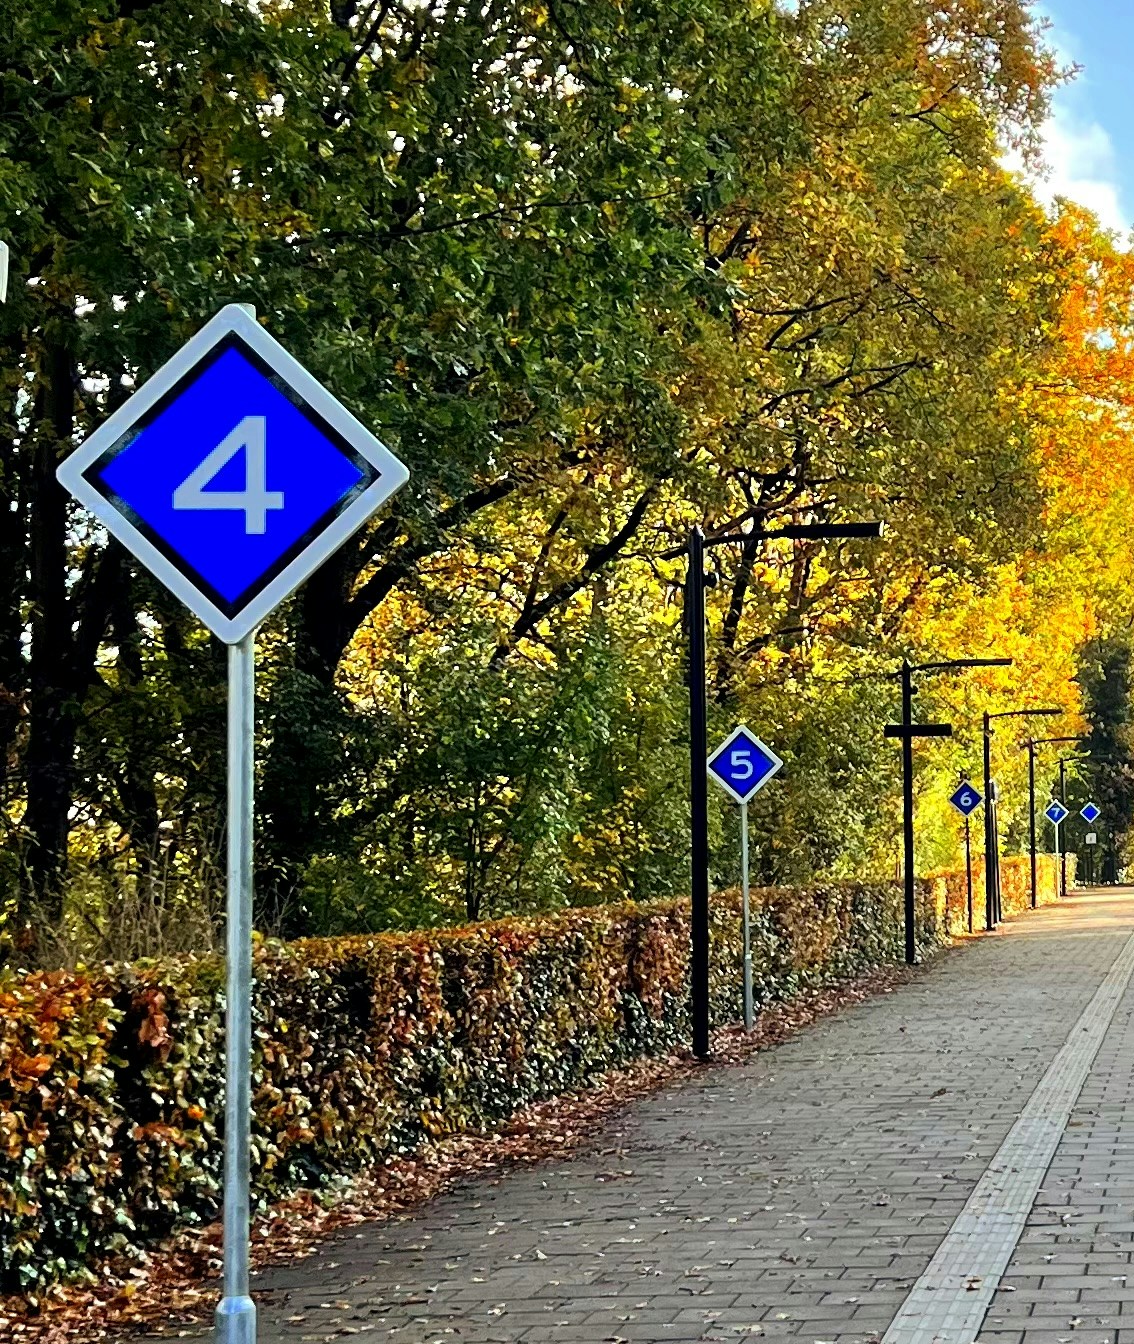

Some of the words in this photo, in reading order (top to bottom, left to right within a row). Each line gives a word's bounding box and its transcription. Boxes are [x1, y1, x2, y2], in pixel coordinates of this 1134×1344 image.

[173, 416, 284, 534] 4
[731, 750, 753, 779] 5
[960, 791, 972, 806] 6
[1051, 807, 1060, 818] 7
